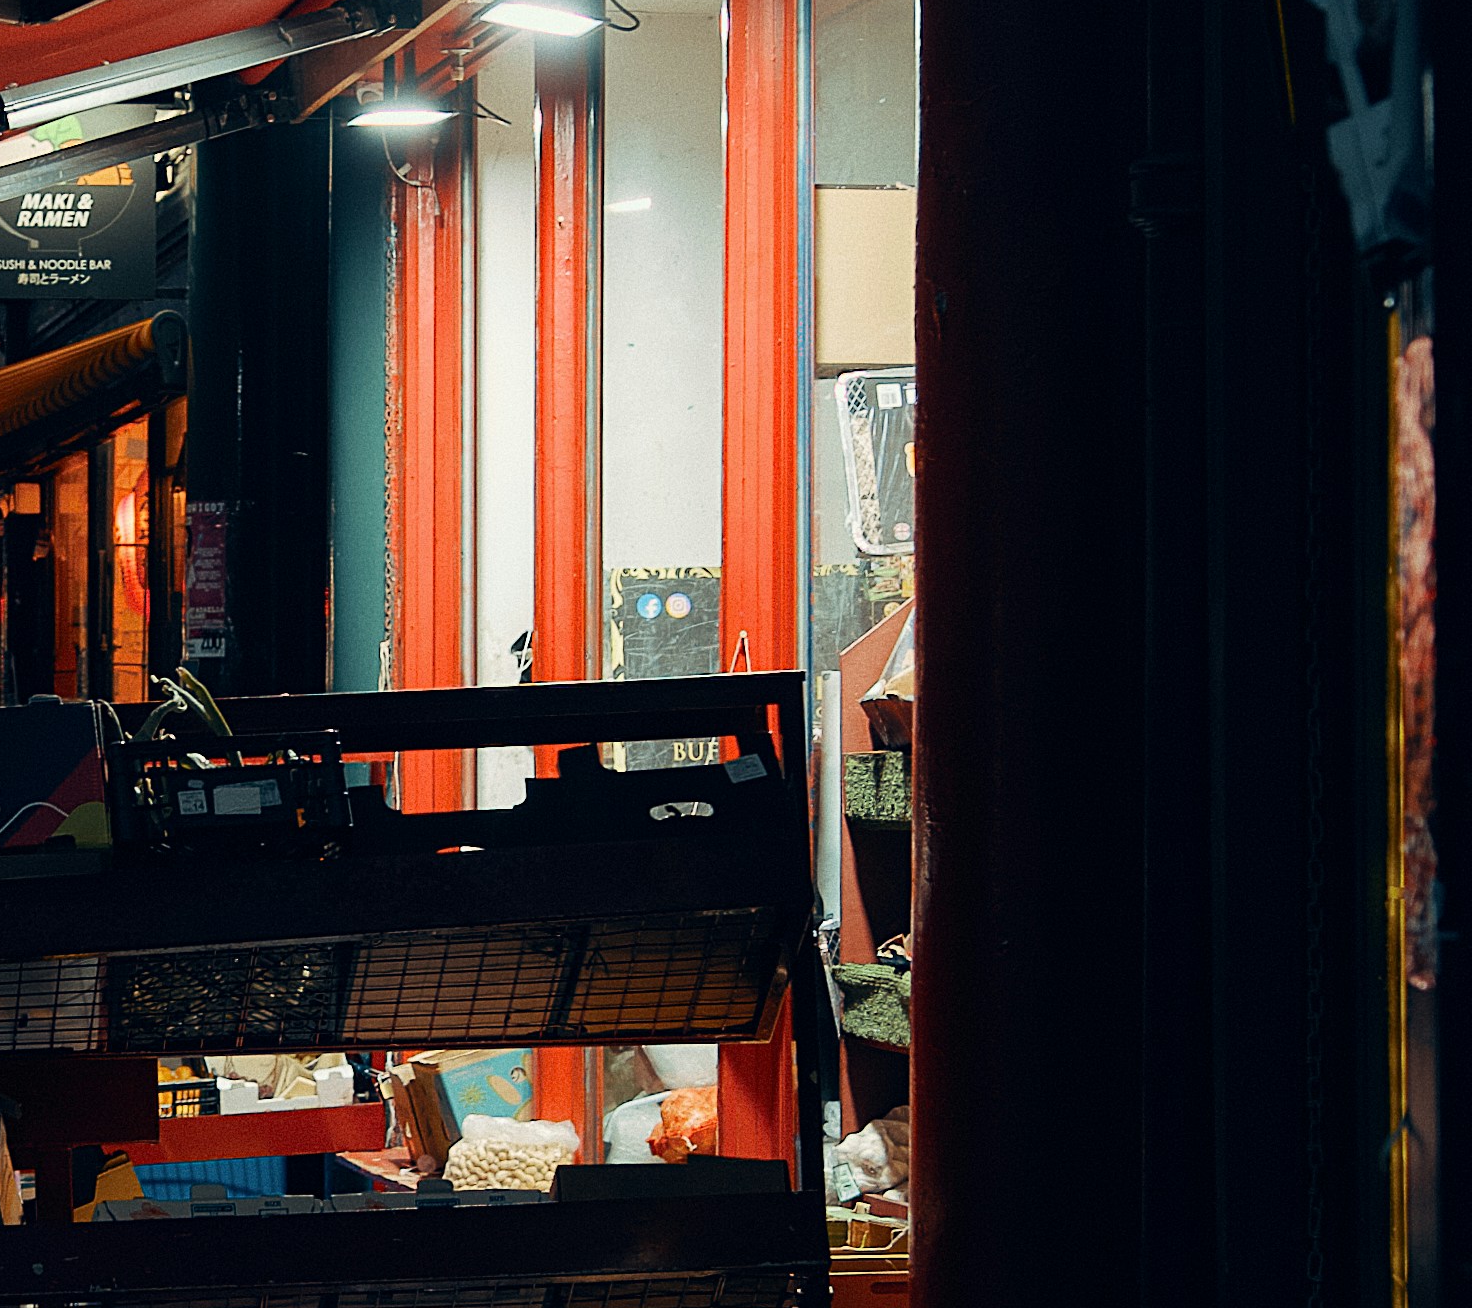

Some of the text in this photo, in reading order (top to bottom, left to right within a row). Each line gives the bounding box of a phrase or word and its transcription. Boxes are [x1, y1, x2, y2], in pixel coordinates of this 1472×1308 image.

[21, 193, 94, 210] MAKI &
[16, 210, 91, 228] RAMEN
[27, 259, 38, 270] &
[39, 259, 88, 271] NOODLE
[89, 259, 112, 270] BAR
